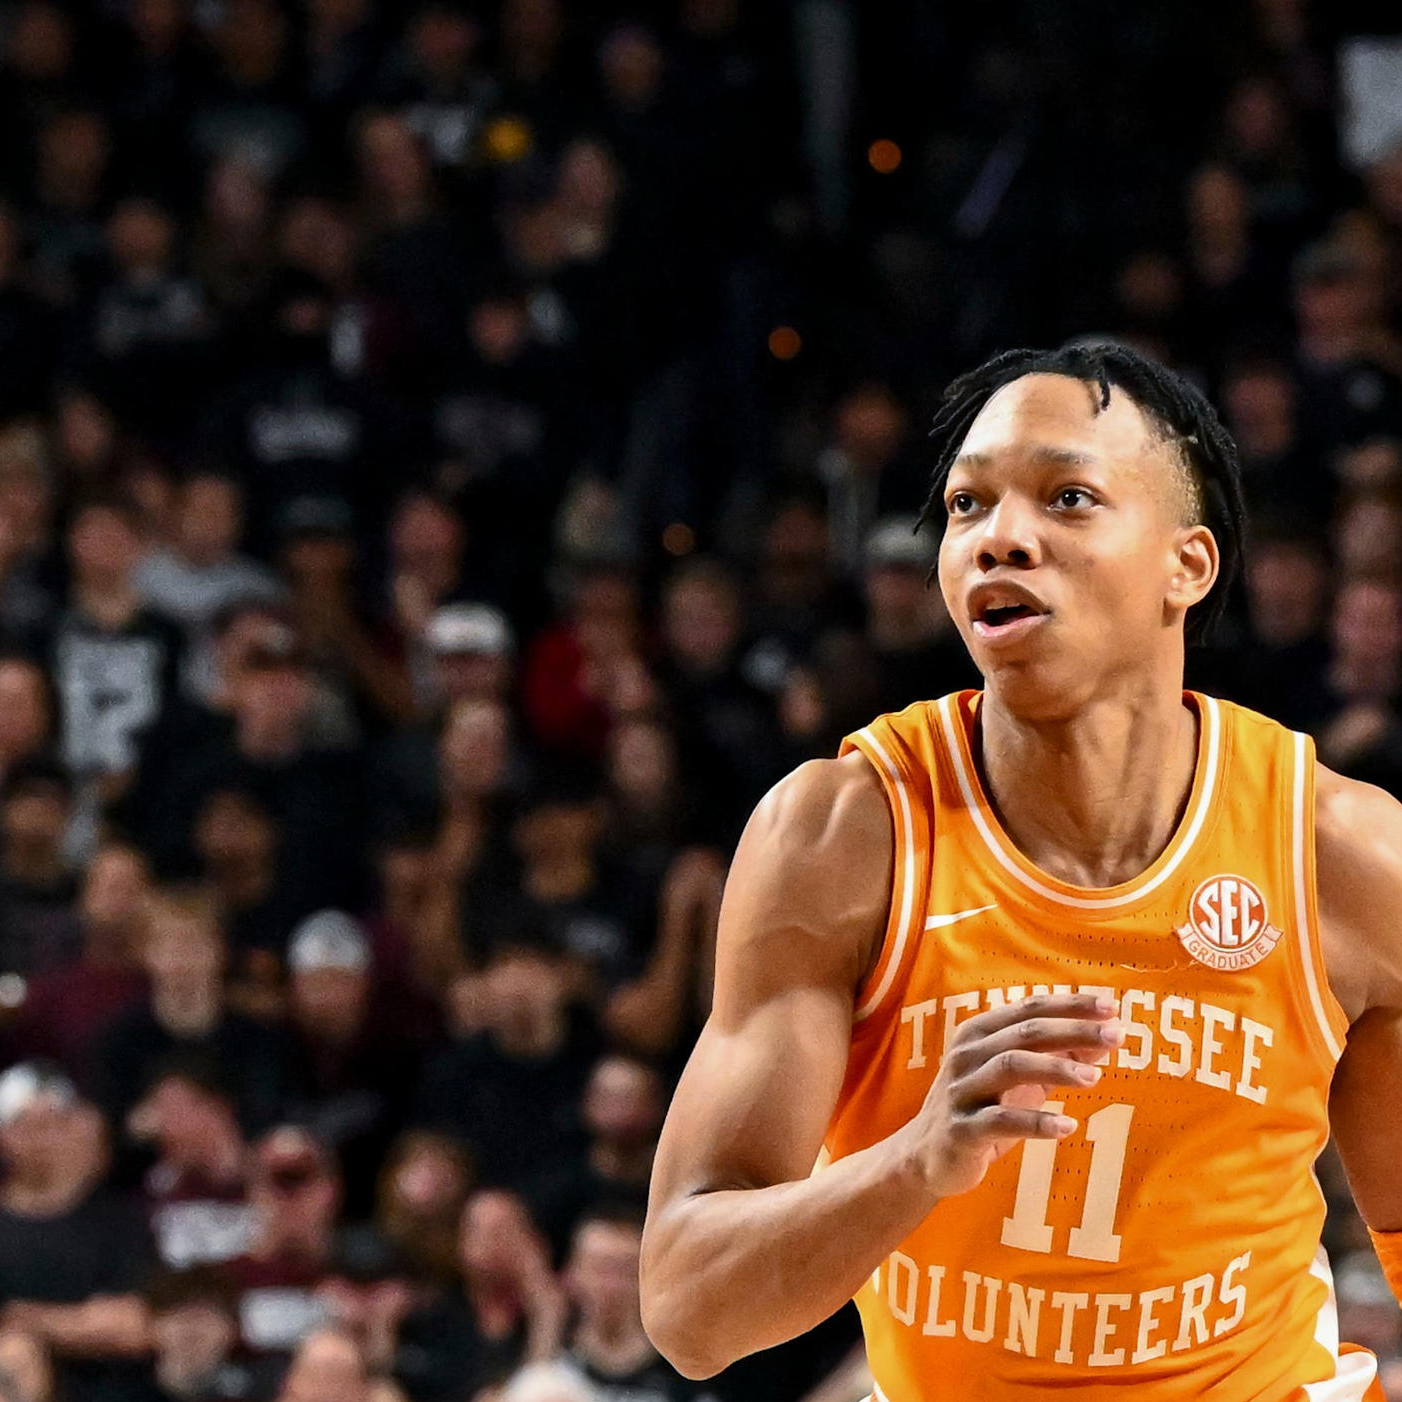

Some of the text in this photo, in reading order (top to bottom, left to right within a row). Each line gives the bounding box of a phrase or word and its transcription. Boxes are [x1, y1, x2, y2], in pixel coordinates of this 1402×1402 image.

[1188, 940, 1269, 970] GRADUATE
[1197, 880, 1261, 946] SEC
[900, 984, 1274, 1106] TSSEE
[1000, 1100, 1136, 1263] 11
[886, 1249, 1252, 1367] OLUNTEERS
